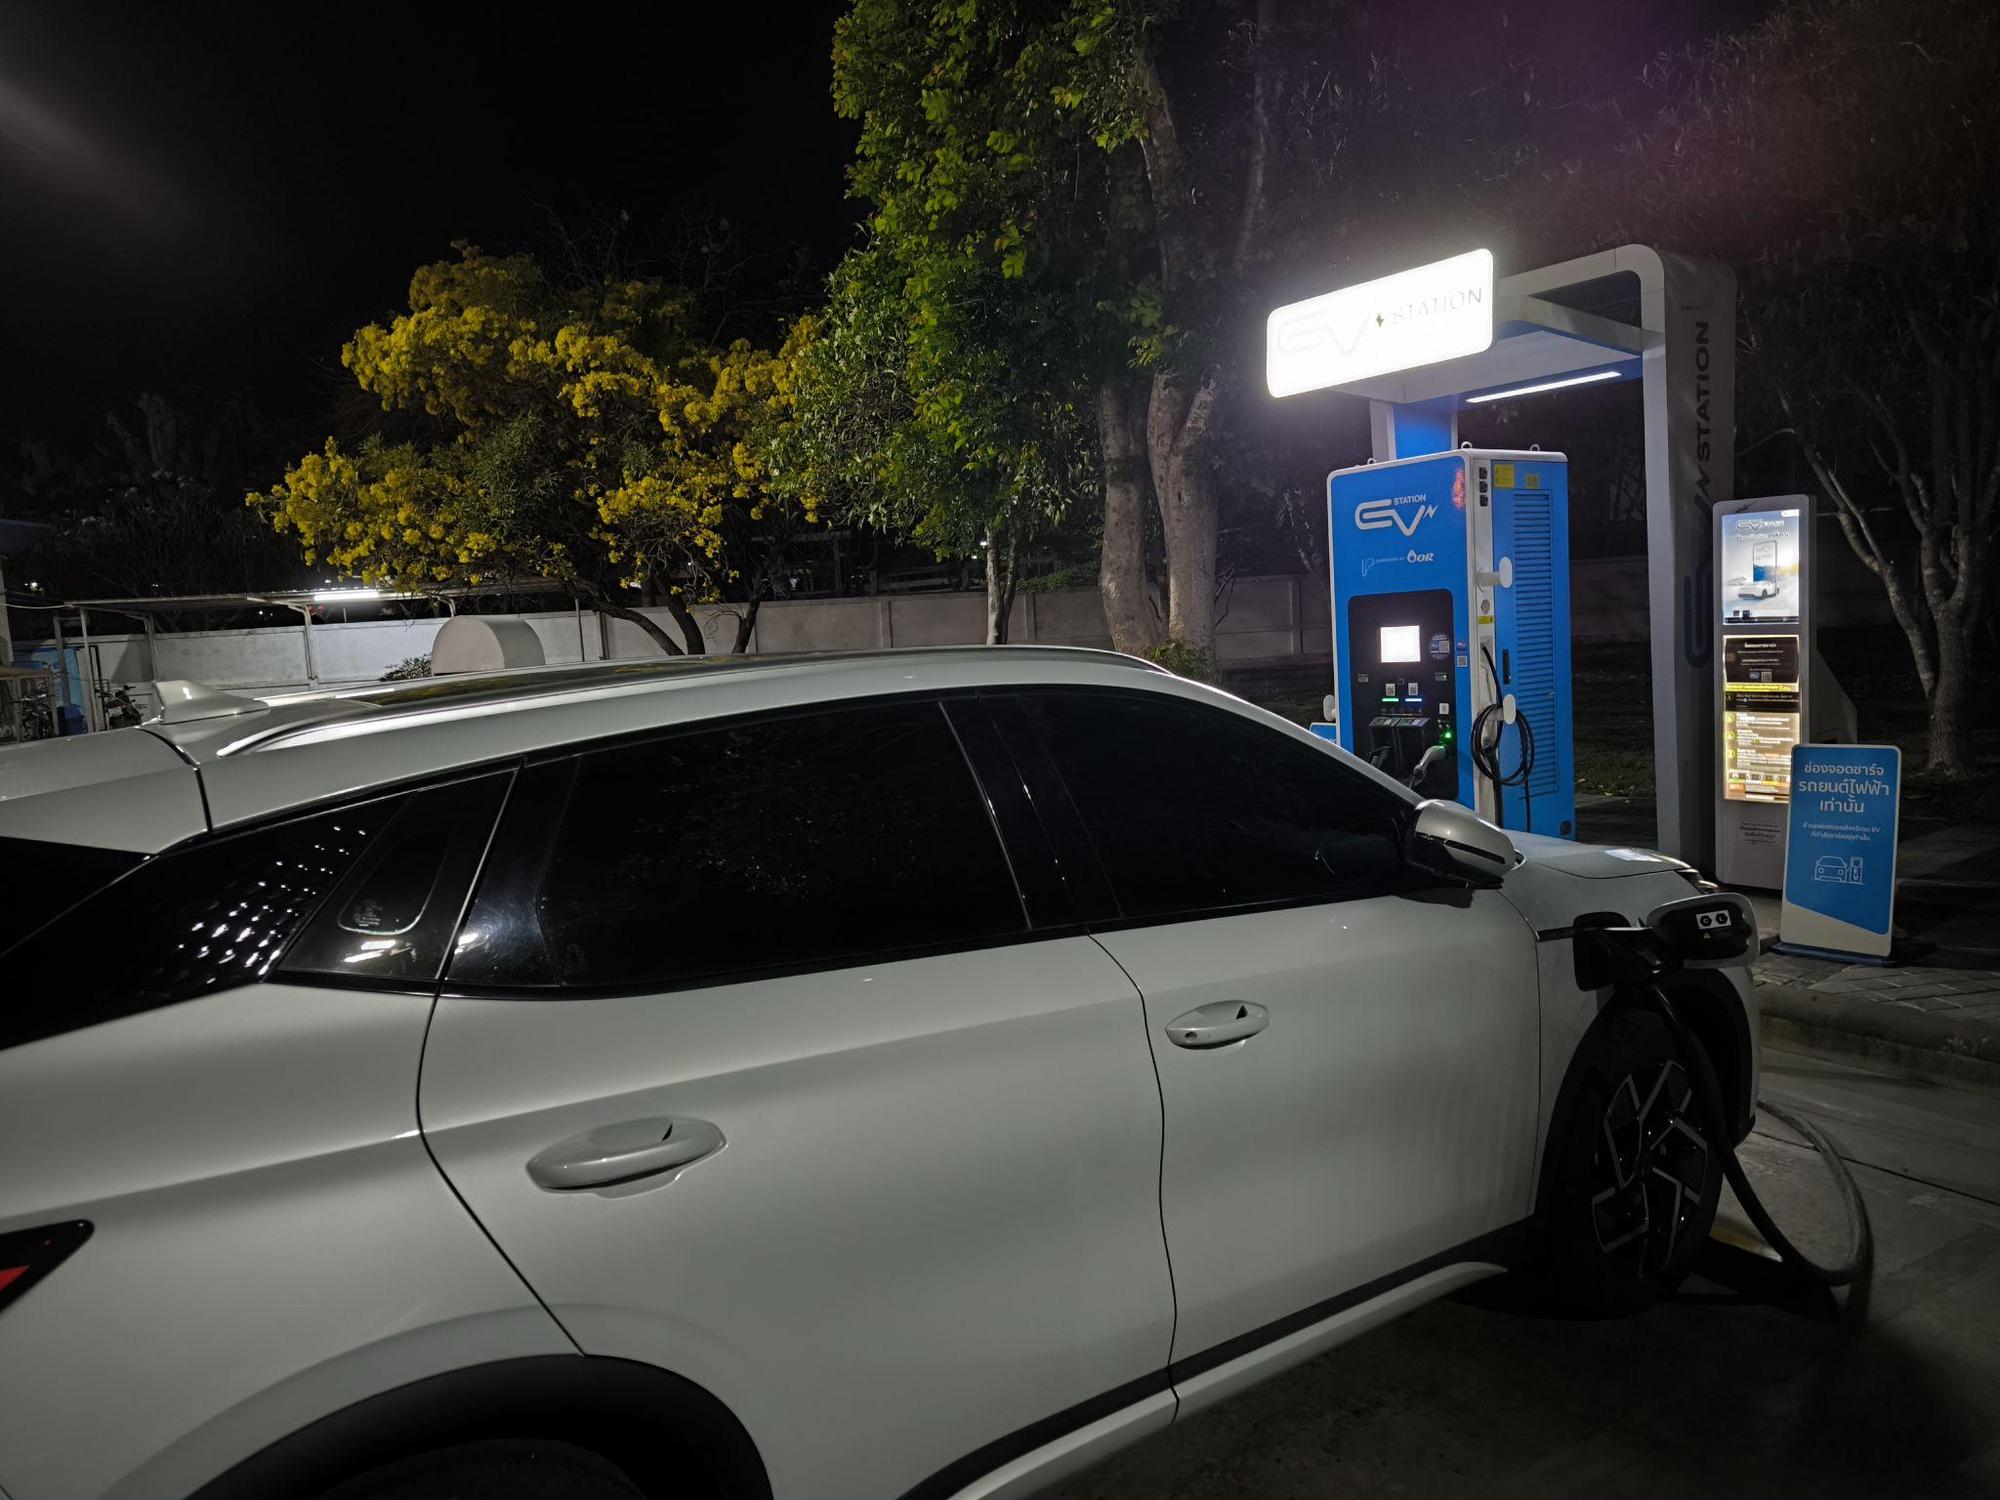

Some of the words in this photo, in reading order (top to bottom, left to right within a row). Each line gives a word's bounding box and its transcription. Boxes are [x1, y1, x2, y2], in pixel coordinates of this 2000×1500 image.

[1392, 287, 1483, 325] STATION
[1696, 321, 1710, 463] STATION
[1393, 494, 1427, 506] STATION
[1354, 499, 1426, 537] EV
[1804, 761, 1885, 776] ช่องจอดชาร์จ
[1798, 778, 1890, 796] รถยนต์ไฟฟ้า
[1820, 794, 1865, 813] เท่านั้น
